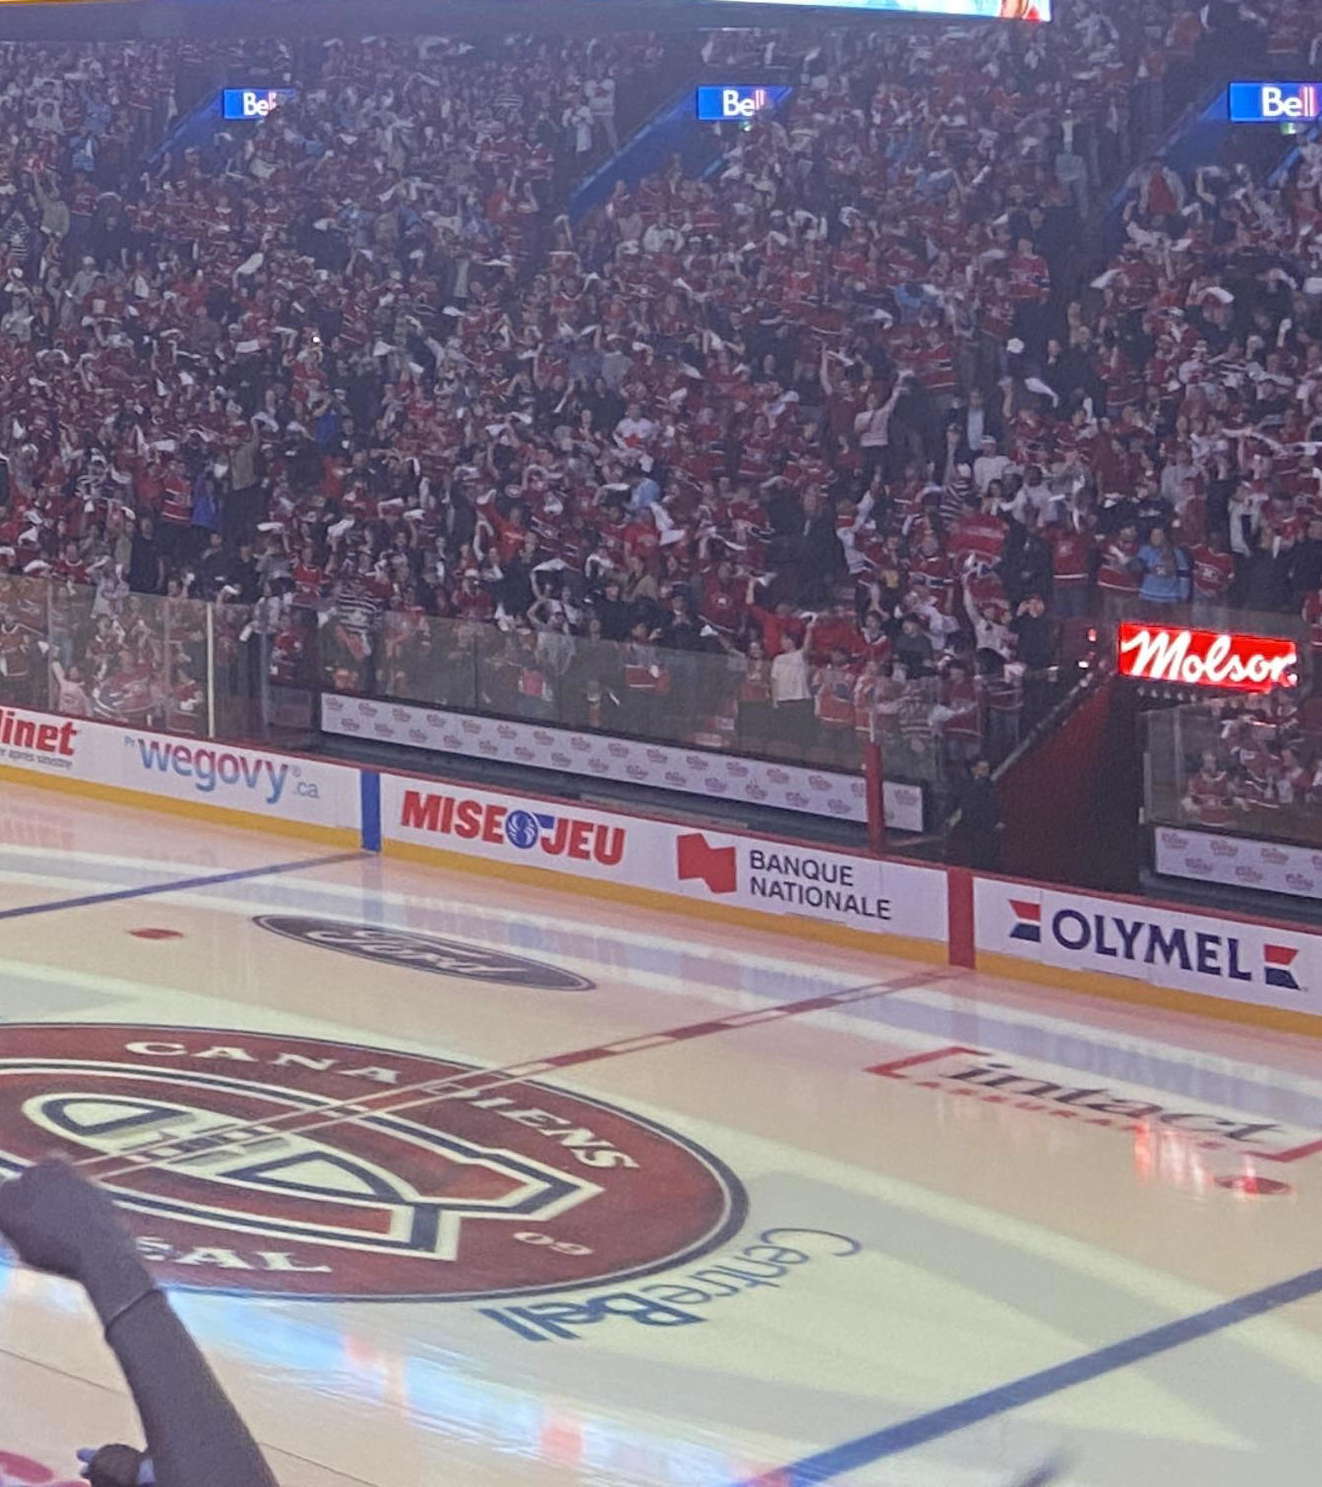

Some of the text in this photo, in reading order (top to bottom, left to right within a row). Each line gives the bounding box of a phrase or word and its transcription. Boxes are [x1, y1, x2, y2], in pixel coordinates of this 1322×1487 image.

[722, 90, 765, 117] Bell
[1261, 86, 1317, 118] Bell
[400, 789, 626, 865] MISE JEU
[749, 849, 854, 888] BANQUE
[749, 875, 893, 920] NATIONALE
[1051, 907, 1253, 982] OLYMEL
[939, 1062, 1286, 1144] intact
[477, 1227, 863, 1343] CentreBell
